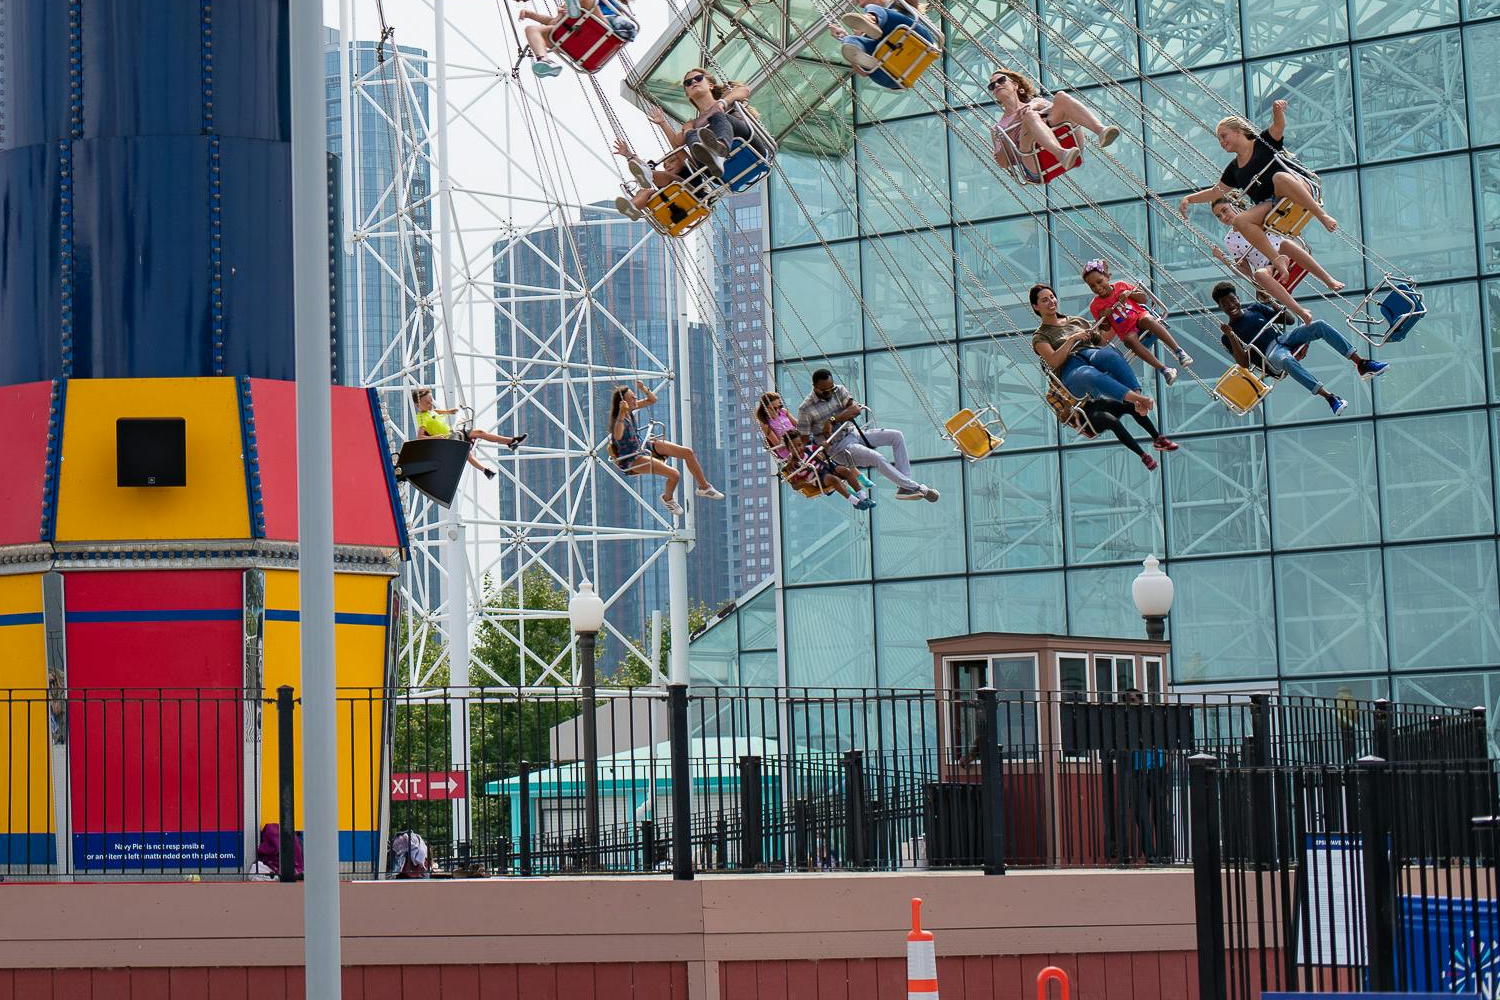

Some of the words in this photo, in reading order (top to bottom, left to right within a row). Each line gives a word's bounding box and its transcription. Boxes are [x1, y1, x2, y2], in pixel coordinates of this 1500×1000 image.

[391, 778, 422, 794] XIT
[166, 843, 204, 851] responsibe
[204, 852, 236, 860] platorm.
